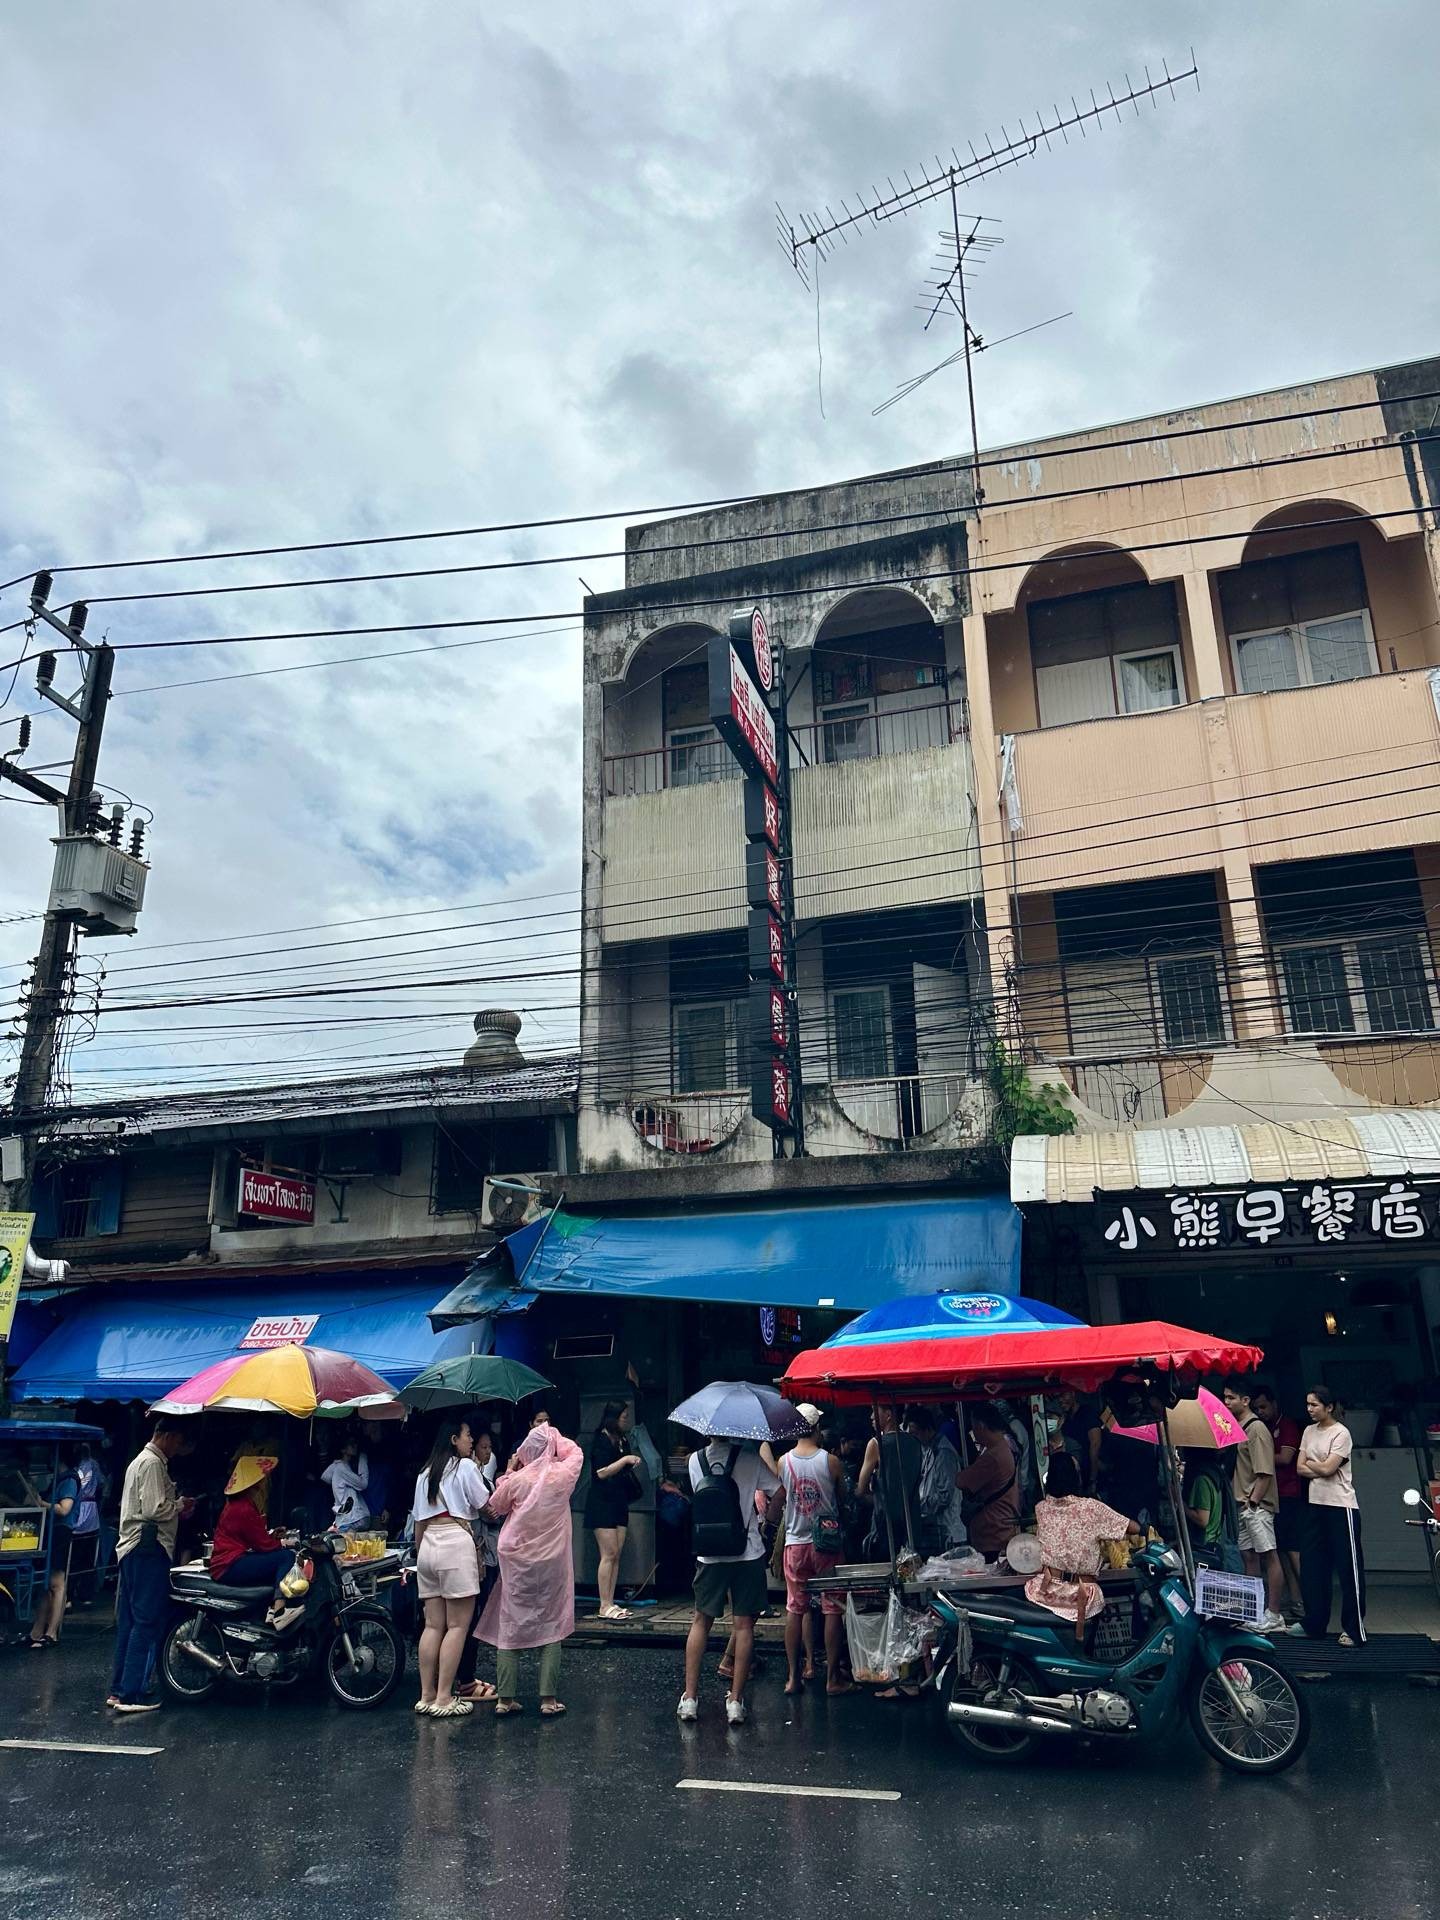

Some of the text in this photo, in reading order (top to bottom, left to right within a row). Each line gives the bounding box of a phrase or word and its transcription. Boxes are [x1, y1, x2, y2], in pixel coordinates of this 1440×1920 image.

[1104, 1182, 1426, 1250] 小熊早餐店
[250, 1317, 315, 1337] ขายบ้าน
